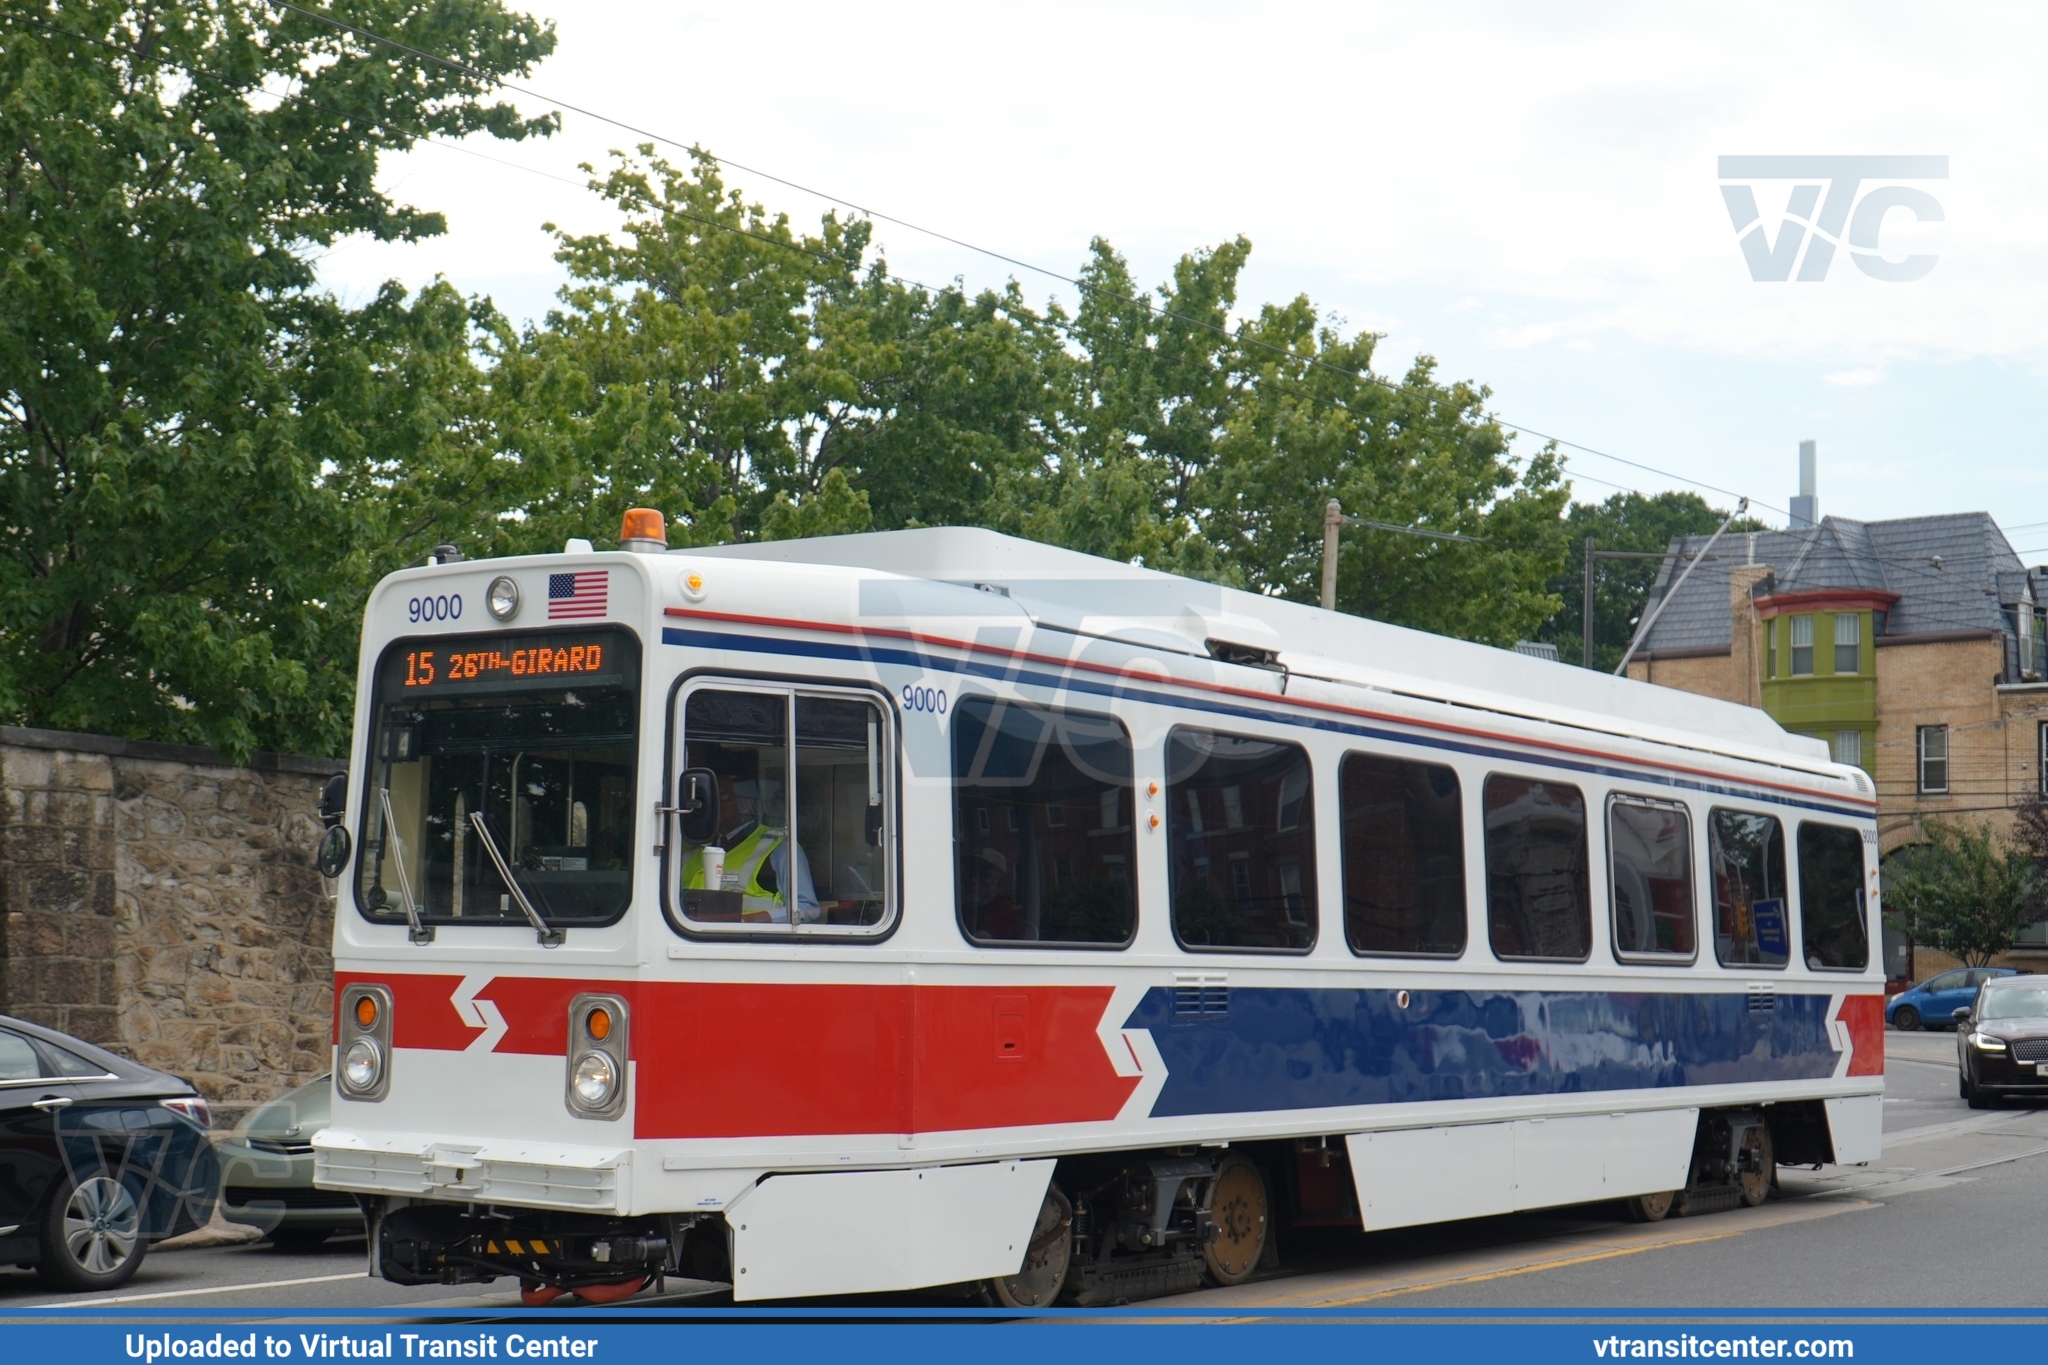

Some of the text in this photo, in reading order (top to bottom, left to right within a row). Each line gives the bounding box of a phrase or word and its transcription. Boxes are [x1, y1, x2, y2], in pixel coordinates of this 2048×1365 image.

[408, 593, 463, 623] 9000
[404, 645, 602, 686] 15 26TH-GIRARD
[902, 684, 948, 715] 9000
[1862, 829, 1877, 845] 9000
